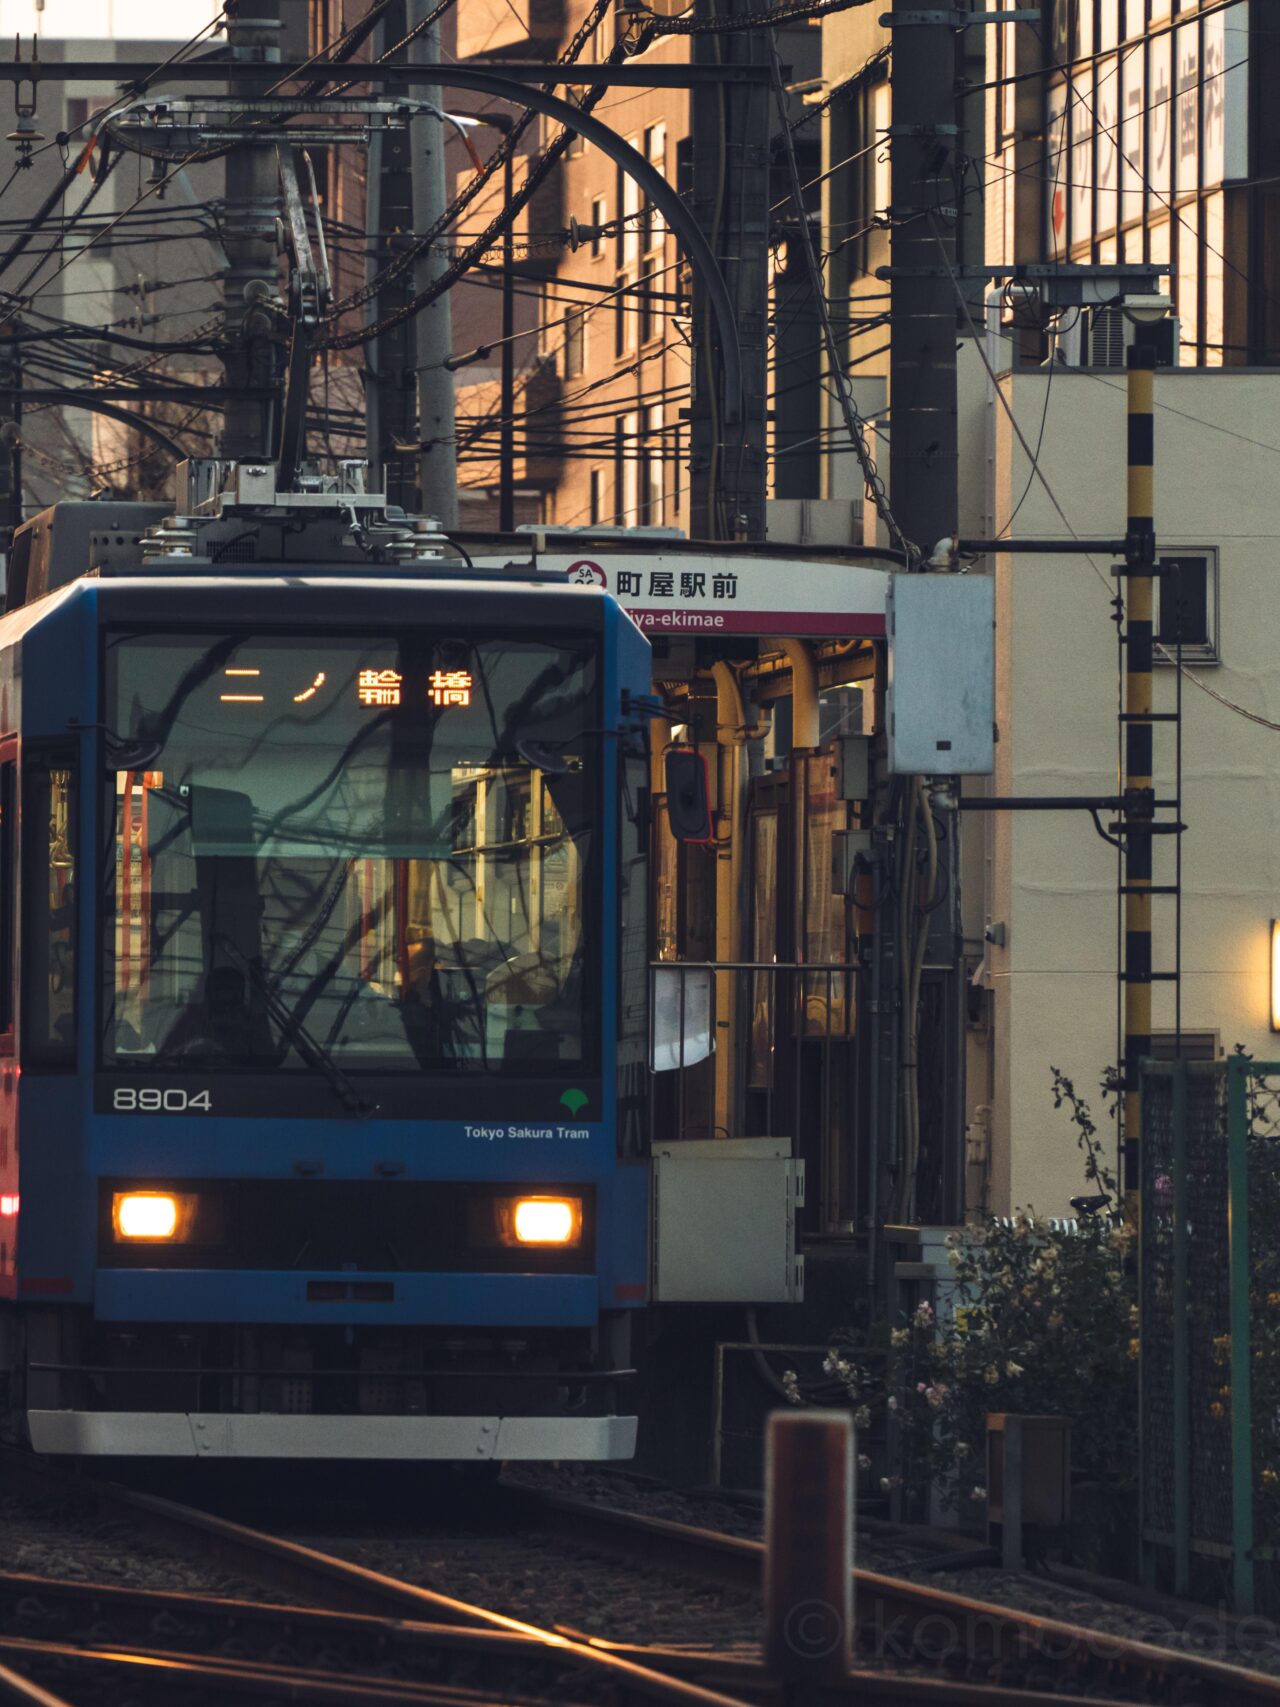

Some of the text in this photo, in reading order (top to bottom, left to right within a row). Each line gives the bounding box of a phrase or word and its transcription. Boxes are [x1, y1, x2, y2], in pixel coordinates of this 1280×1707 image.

[579, 568, 593, 578] SA
[616, 571, 738, 599] 町屋駅前
[112, 1088, 213, 1112] 8904
[463, 1126, 590, 1142] Tokyo Sakura Tram
